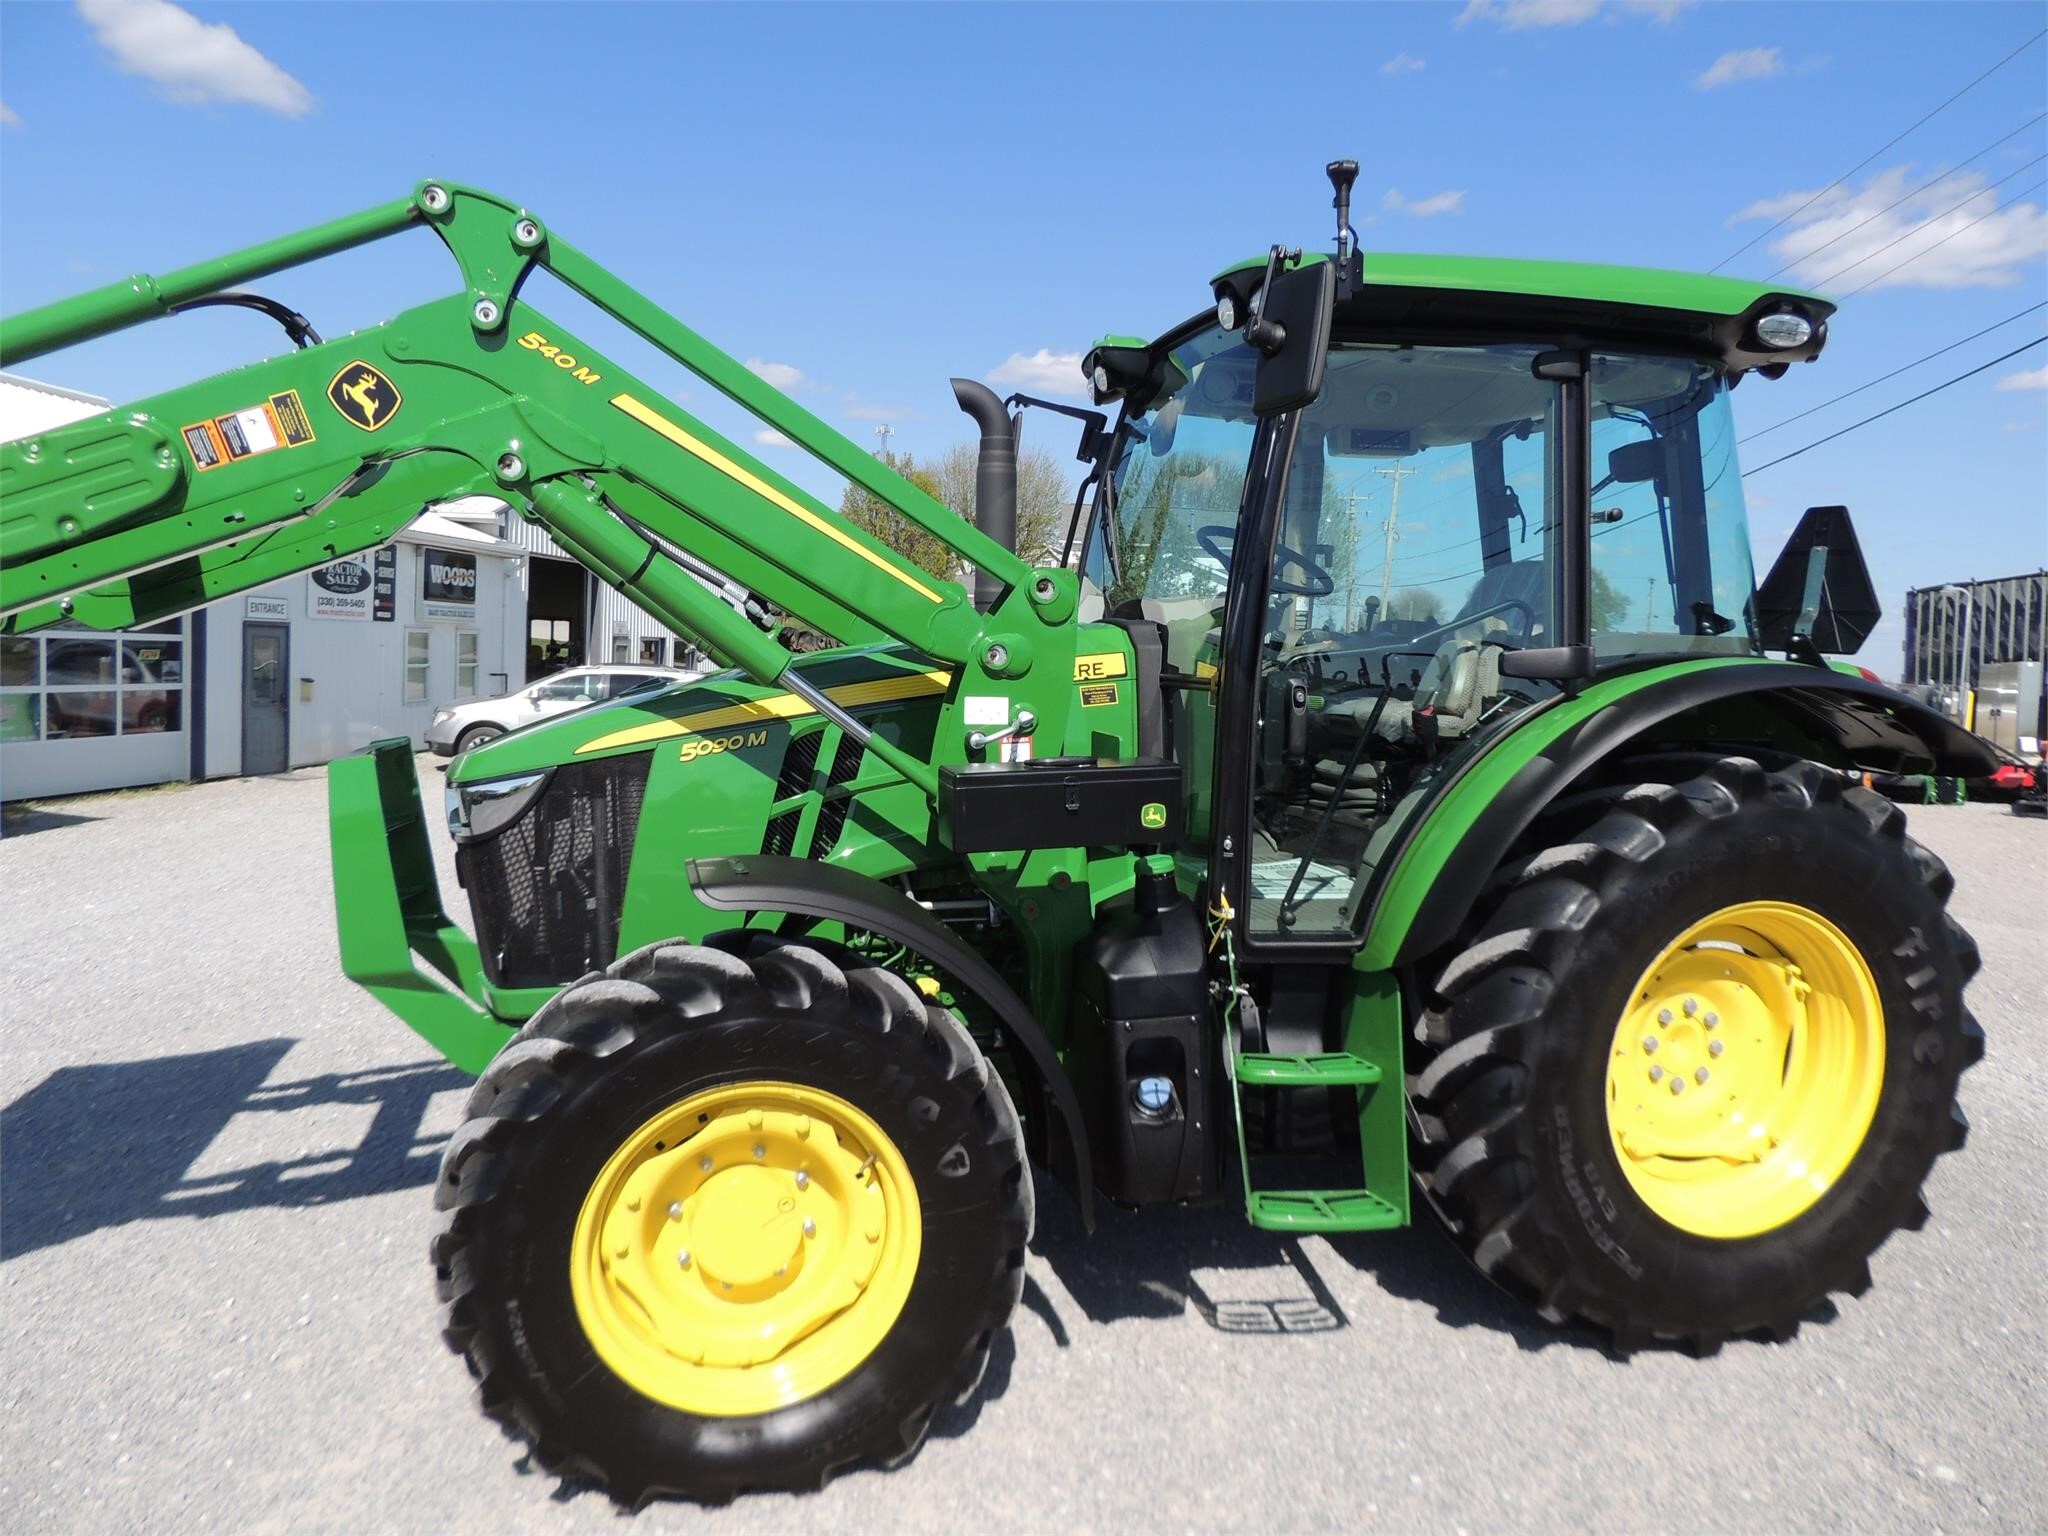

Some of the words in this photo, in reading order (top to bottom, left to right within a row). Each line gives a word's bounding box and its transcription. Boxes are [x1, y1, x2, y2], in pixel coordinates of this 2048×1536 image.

[321, 563, 362, 576] TRACTOR
[430, 564, 475, 588] WOODS
[326, 573, 360, 585] SALES
[250, 601, 286, 615] ENTRANCE
[680, 735, 744, 762] 5090
